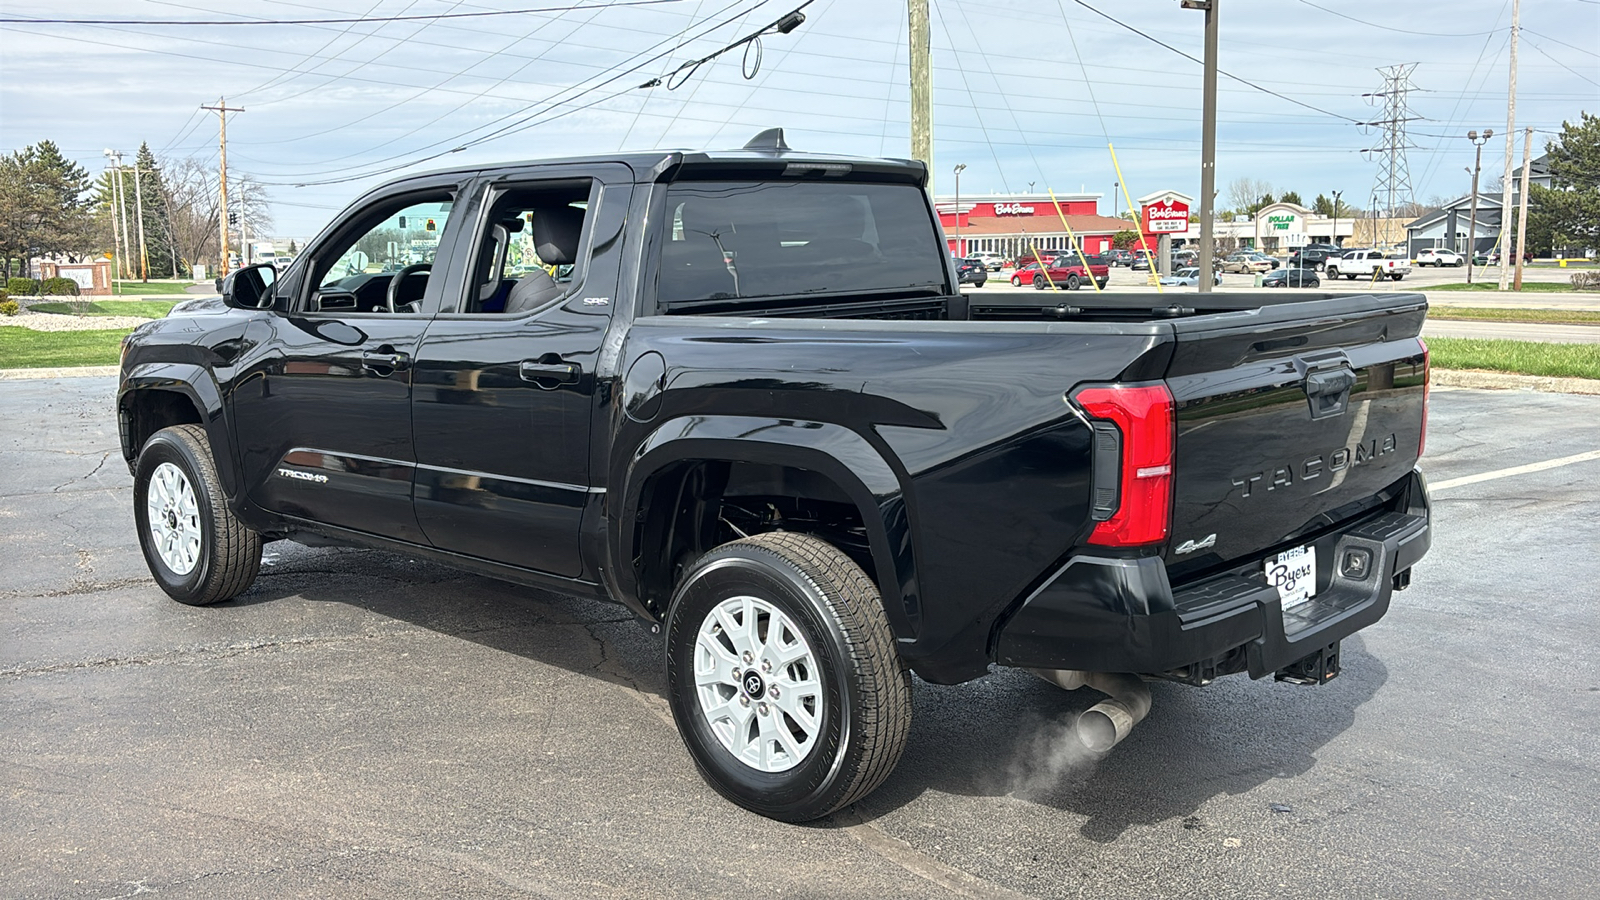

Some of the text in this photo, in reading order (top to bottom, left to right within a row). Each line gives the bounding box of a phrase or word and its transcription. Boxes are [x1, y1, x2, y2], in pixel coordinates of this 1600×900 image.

[994, 203, 1012, 215] Bob
[1148, 207, 1187, 219] Bob Evans
[1268, 215, 1295, 223] DOLLAR
[1273, 223, 1290, 231] TREE
[583, 297, 609, 306] SR5
[1231, 433, 1398, 498] TACOMA
[278, 468, 329, 484] TACOMA
[1278, 546, 1305, 562] BYERS
[1269, 564, 1311, 591] Byers
